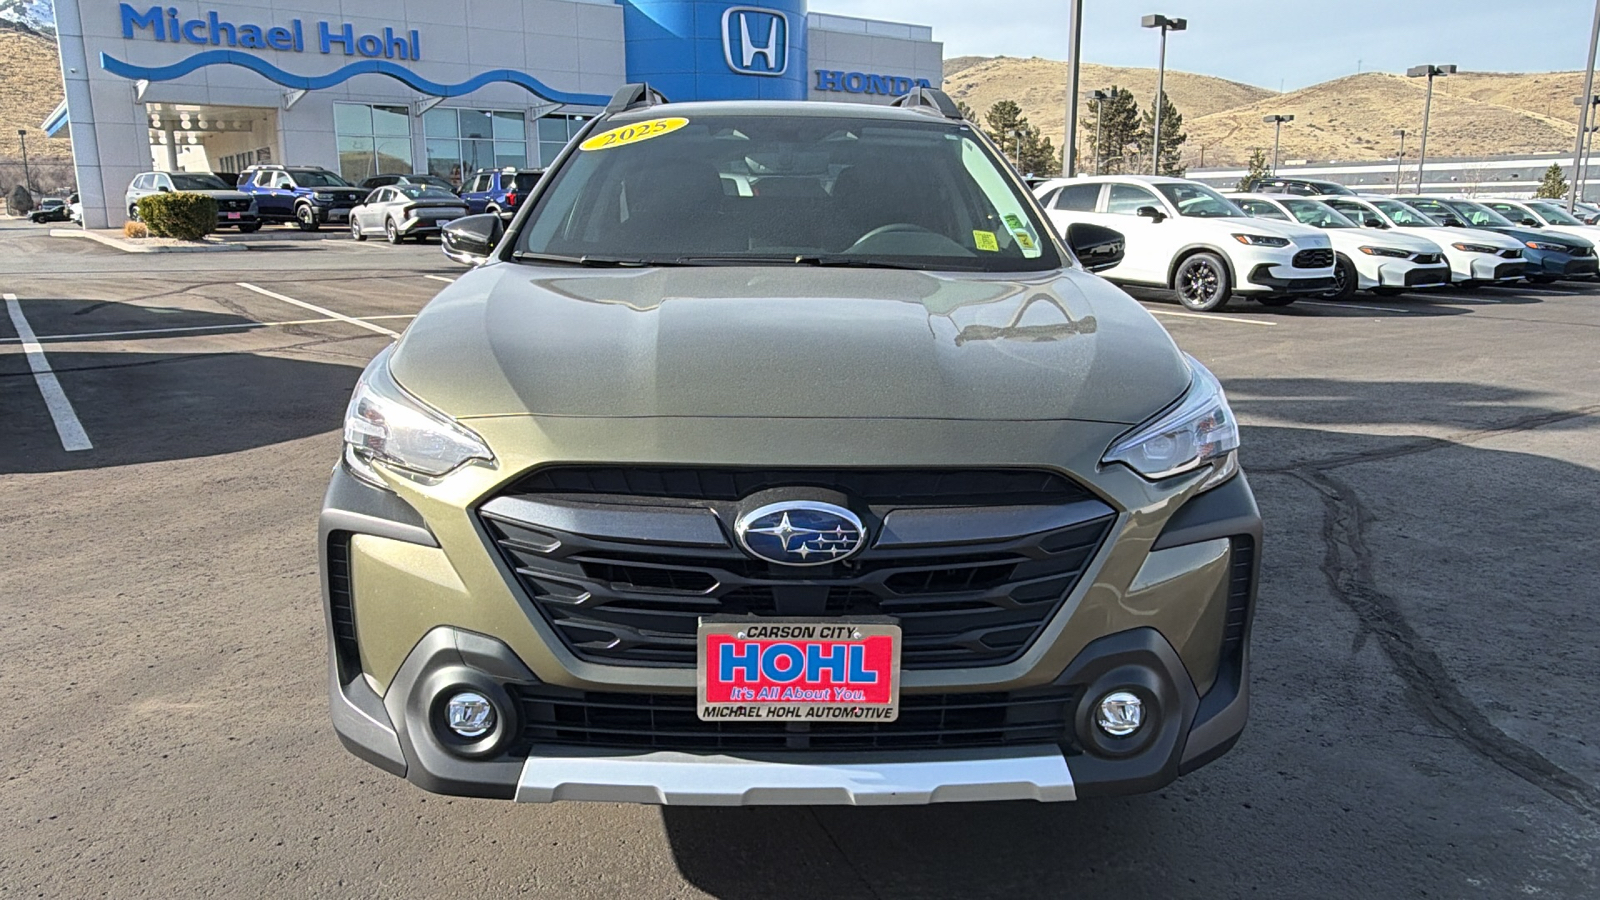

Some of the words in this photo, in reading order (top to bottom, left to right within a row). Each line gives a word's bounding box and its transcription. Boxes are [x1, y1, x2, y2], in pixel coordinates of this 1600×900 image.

[119, 3, 303, 52] Michael
[318, 21, 420, 61] Hohl
[603, 120, 668, 146] 2025
[746, 626, 816, 639] CARSON
[819, 627, 857, 639] CITY
[719, 643, 878, 683] HOHL
[730, 686, 755, 700] It's
[757, 687, 780, 700] All
[782, 687, 830, 700] About
[833, 687, 866, 701] You.
[702, 706, 762, 718] MICHAEL
[766, 706, 803, 718] HOHL
[805, 706, 894, 719] AUTOMOTIVE
